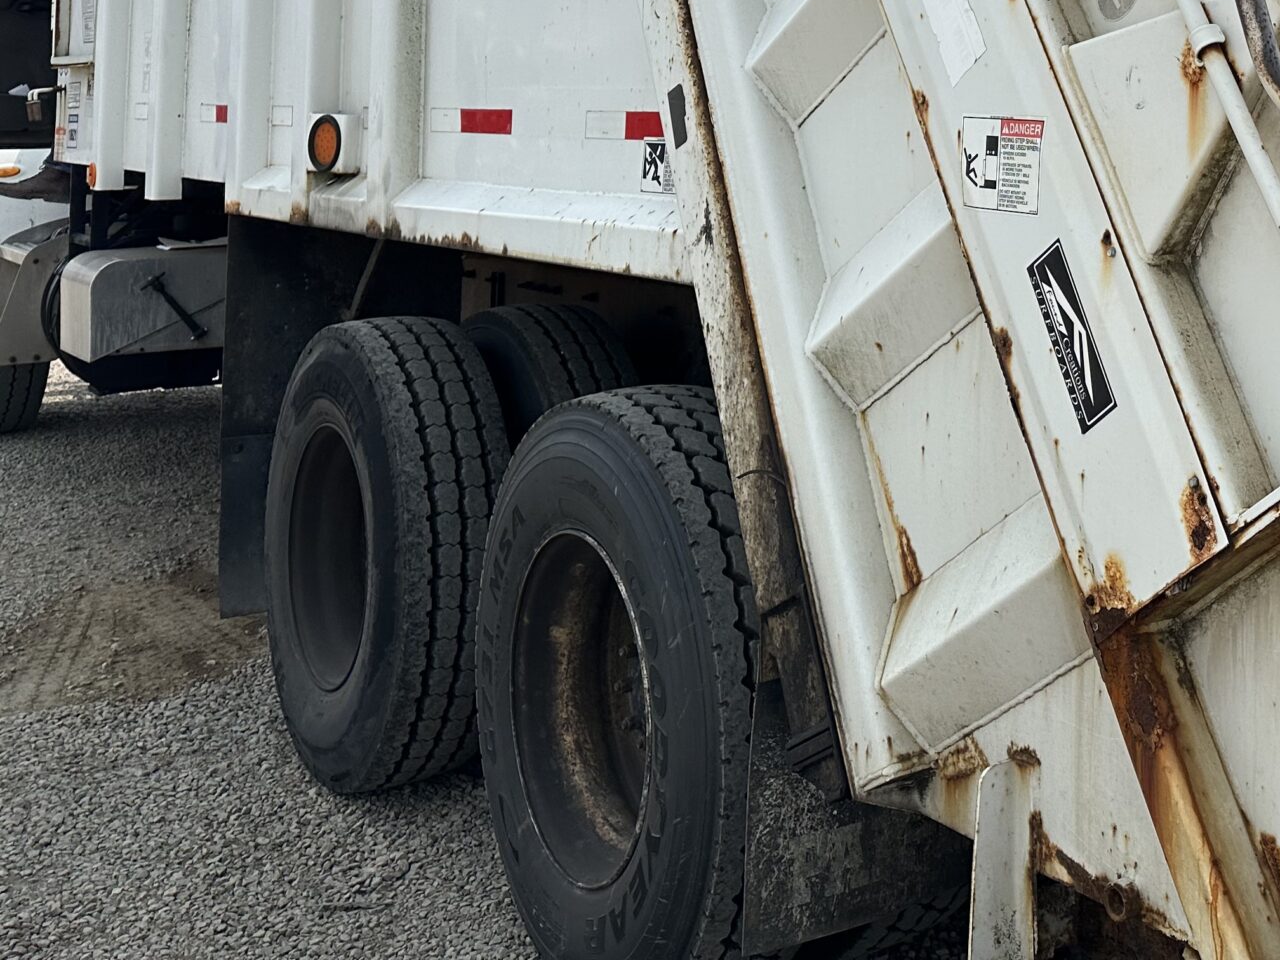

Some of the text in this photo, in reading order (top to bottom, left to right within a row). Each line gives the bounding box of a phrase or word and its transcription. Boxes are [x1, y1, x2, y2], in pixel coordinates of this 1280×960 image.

[1010, 123, 1041, 135] DANGER
[1030, 276, 1083, 420] SURFBOARDS
[1062, 337, 1087, 400] Creations
[584, 559, 668, 953] GOODYEAR
